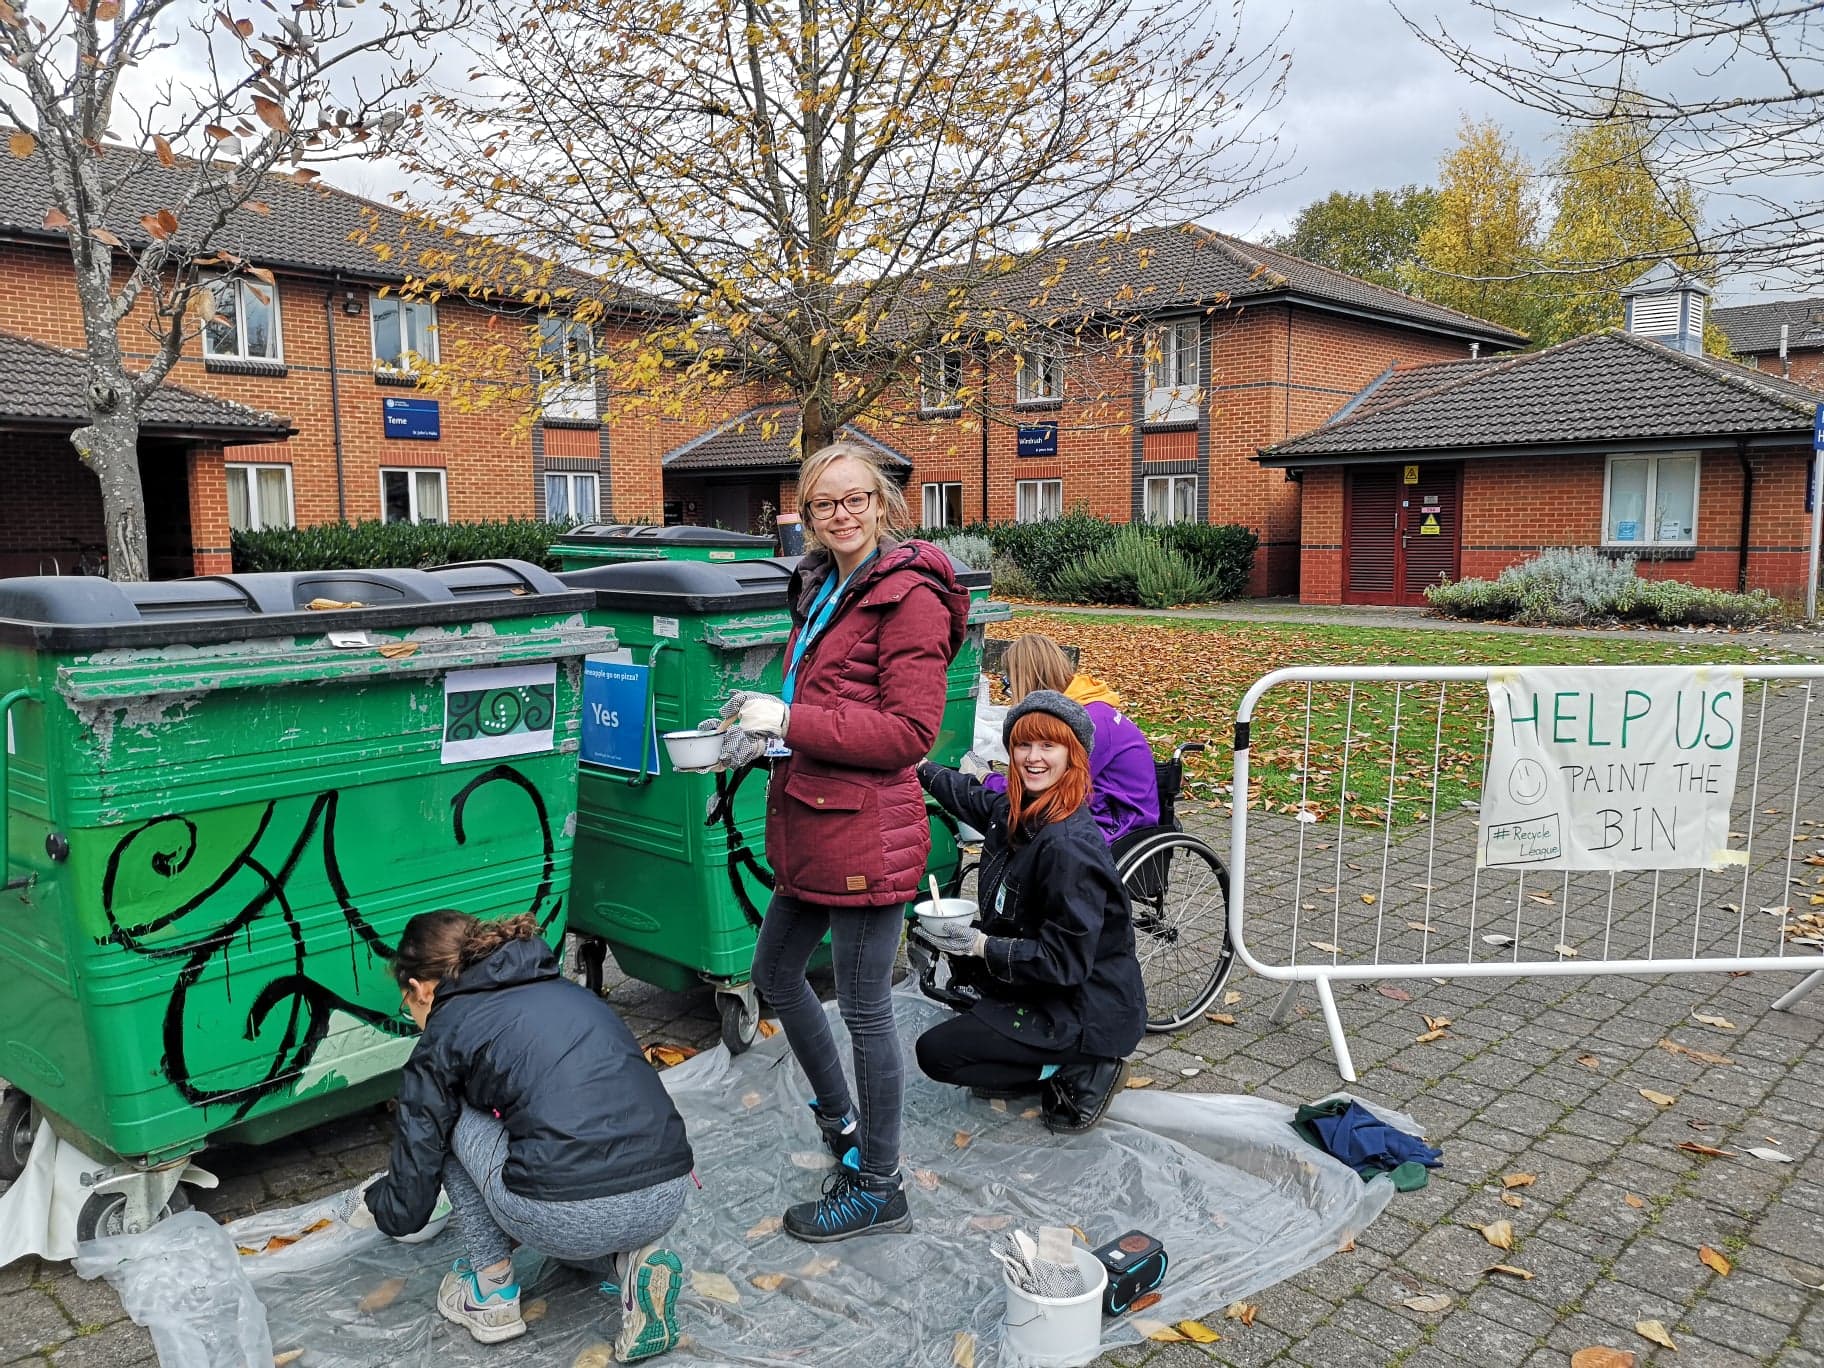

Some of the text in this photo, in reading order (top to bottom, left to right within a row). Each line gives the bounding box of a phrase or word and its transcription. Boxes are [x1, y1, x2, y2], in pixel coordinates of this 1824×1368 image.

[387, 416, 408, 425] Teme
[620, 672, 639, 682] pizza?
[591, 702, 619, 728] Yes
[1506, 690, 1735, 750] HELP US
[1559, 762, 1723, 794] PAINT THE
[1587, 805, 1678, 852] BIN
[1520, 843, 1559, 859] League
